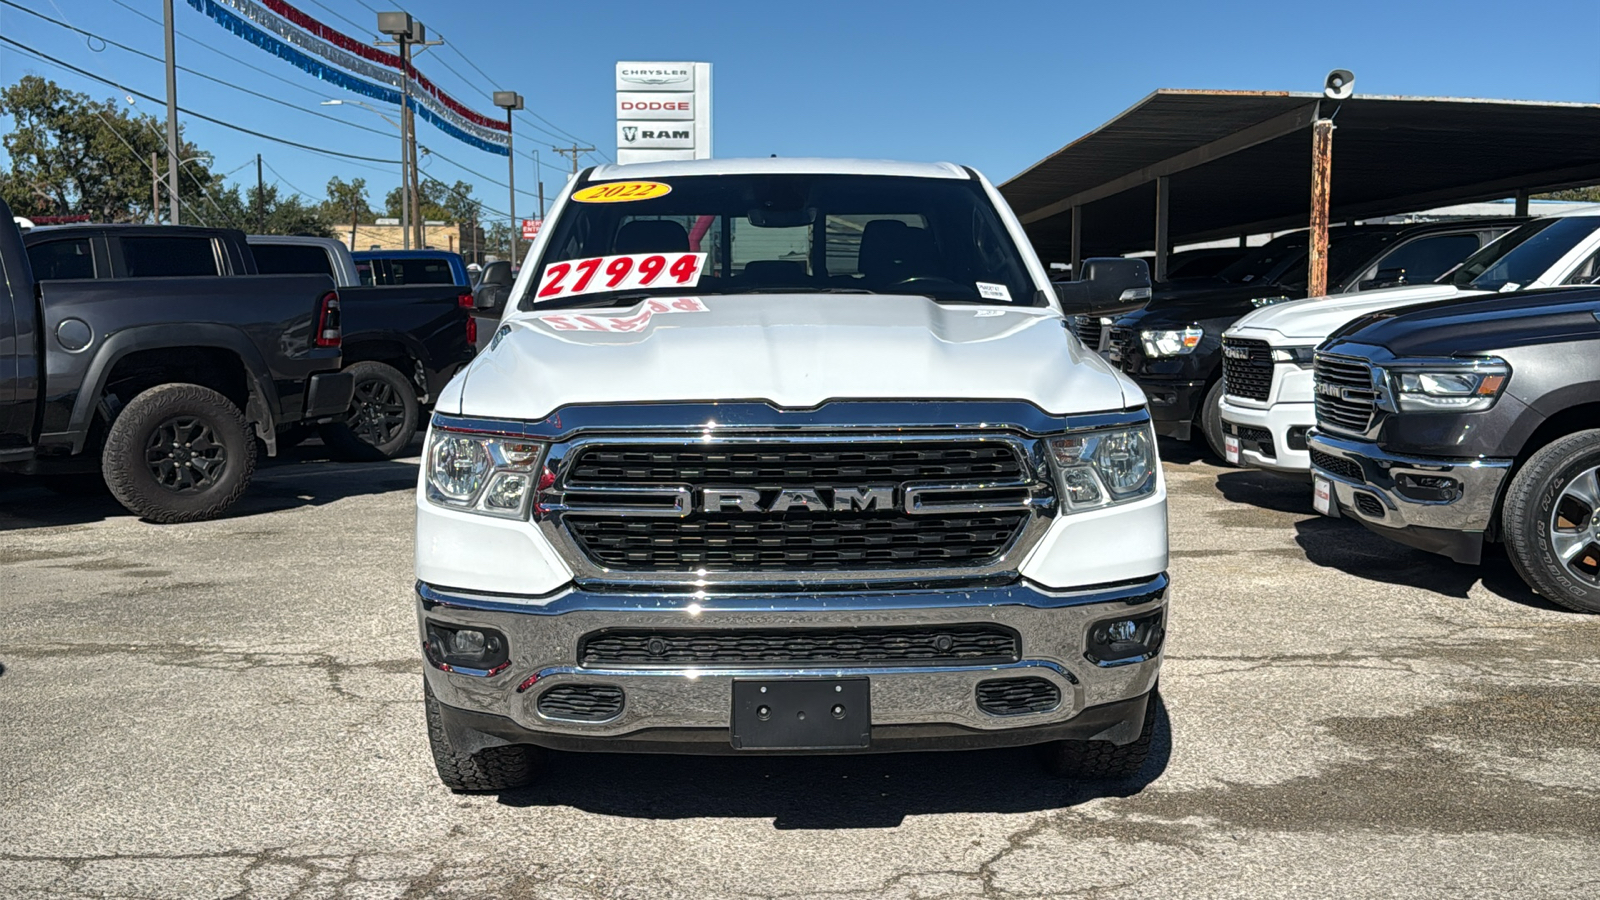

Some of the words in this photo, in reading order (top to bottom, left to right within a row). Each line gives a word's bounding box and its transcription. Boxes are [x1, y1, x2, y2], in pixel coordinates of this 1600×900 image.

[621, 101, 690, 111] DODGE
[641, 130, 690, 139] RAM
[586, 183, 657, 200] 2022
[538, 254, 700, 299] 27994
[702, 486, 895, 513] RAM
